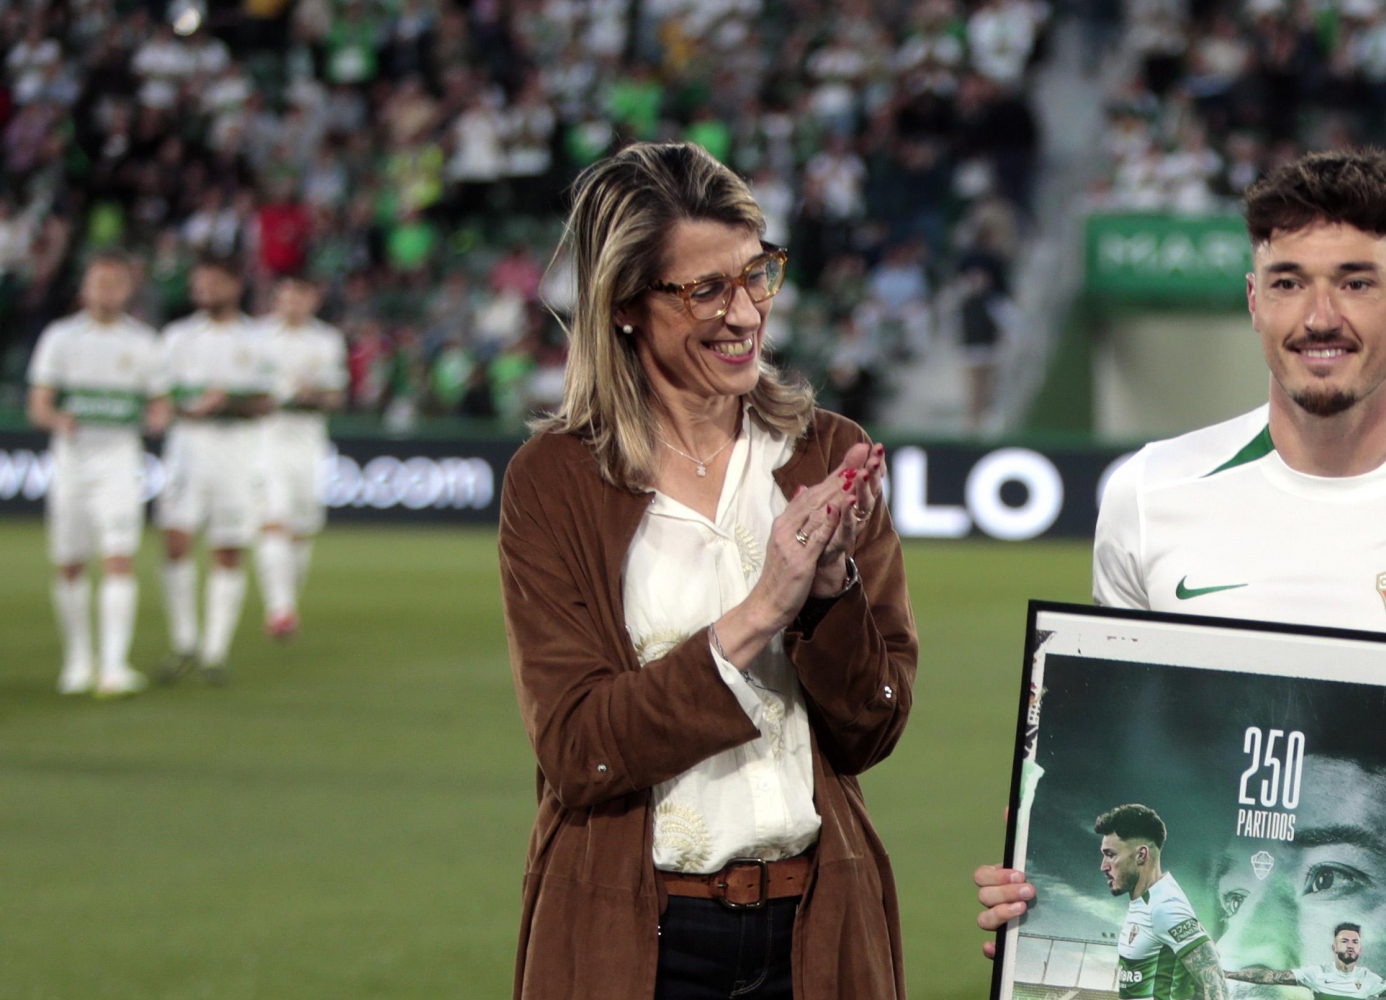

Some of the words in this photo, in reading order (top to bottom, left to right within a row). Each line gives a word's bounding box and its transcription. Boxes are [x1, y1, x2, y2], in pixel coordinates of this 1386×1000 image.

[884, 445, 1065, 541] LO
[1239, 726, 1306, 809] 250
[1236, 808, 1296, 841] PARTIDOS
